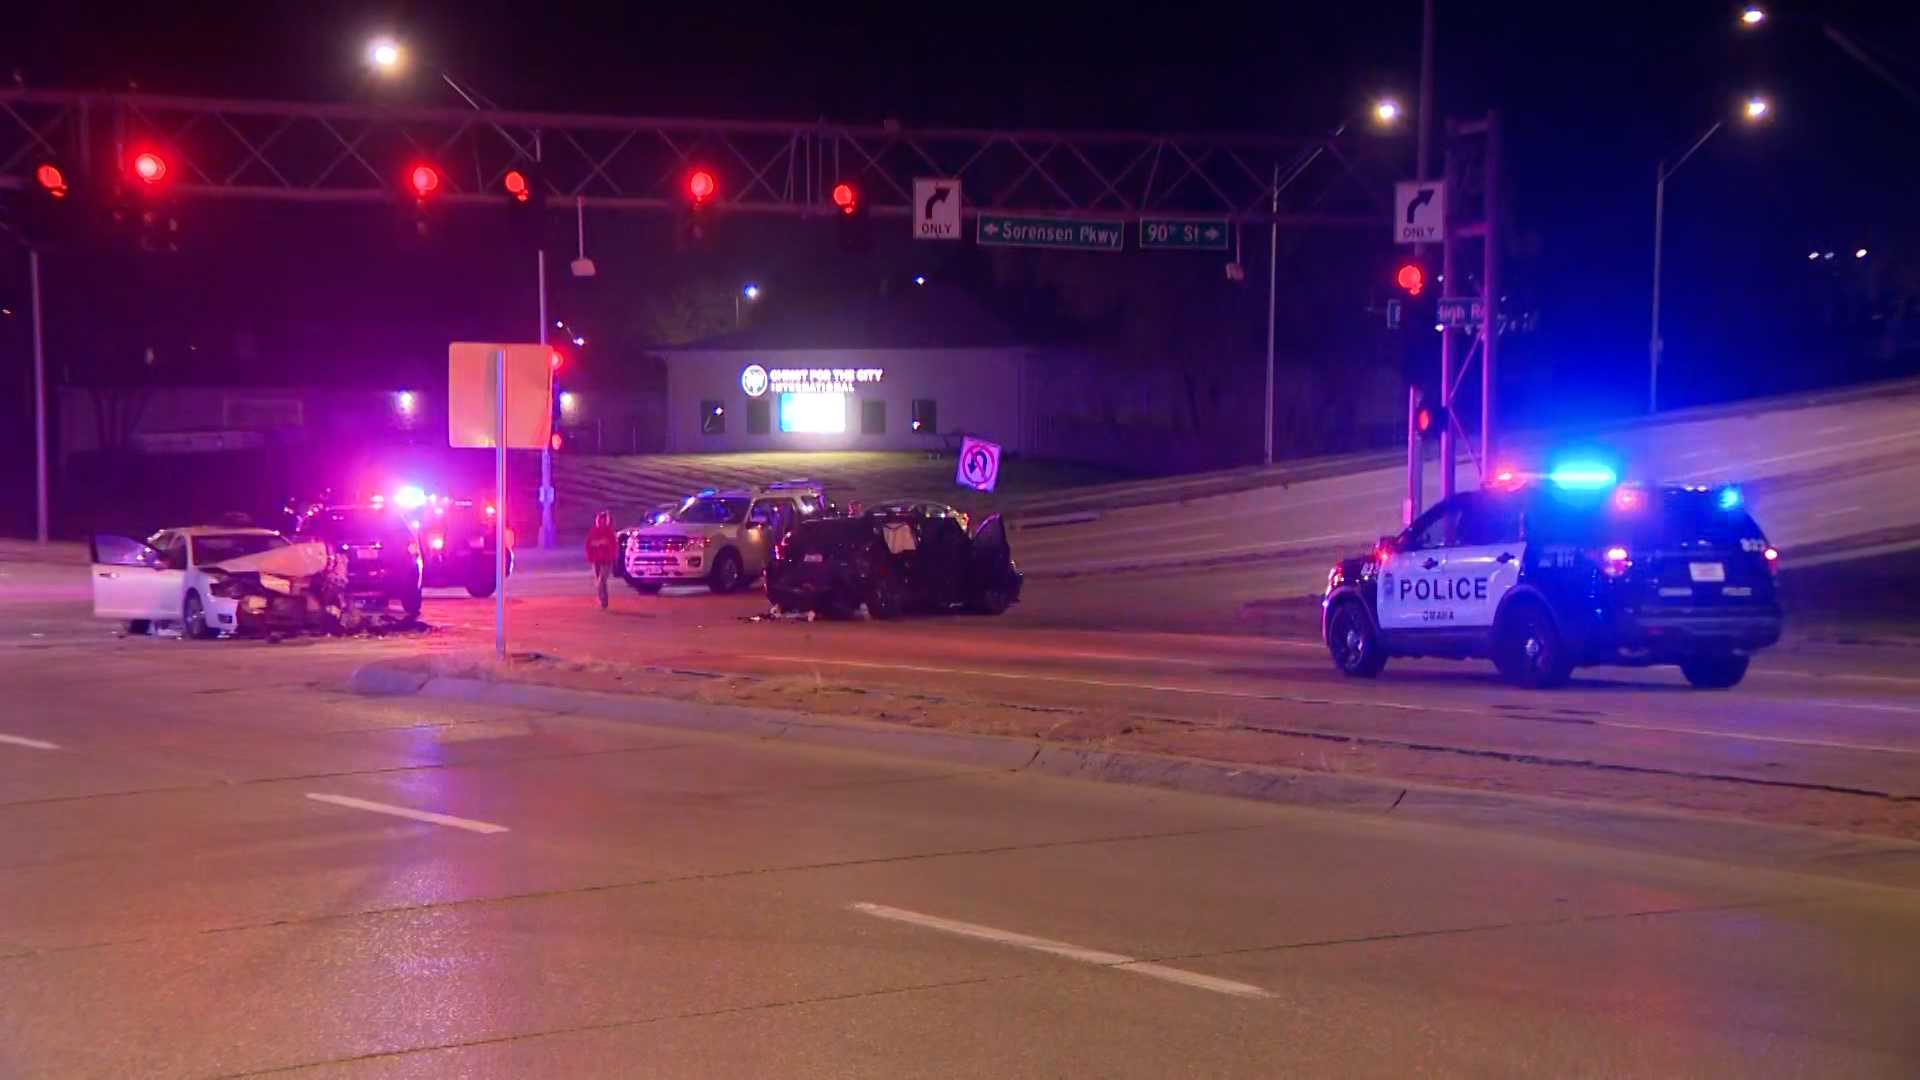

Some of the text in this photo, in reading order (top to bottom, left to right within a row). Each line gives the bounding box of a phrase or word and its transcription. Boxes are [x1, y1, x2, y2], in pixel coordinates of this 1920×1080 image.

[921, 223, 952, 235] ONLY
[1002, 221, 1119, 248] Sorensen Pkwy
[1183, 223, 1200, 242] St
[1403, 226, 1435, 238] ONLY
[810, 369, 831, 381] FOR
[832, 369, 855, 381] THE
[856, 369, 883, 381] CITY
[1400, 577, 1488, 600] POLICE
